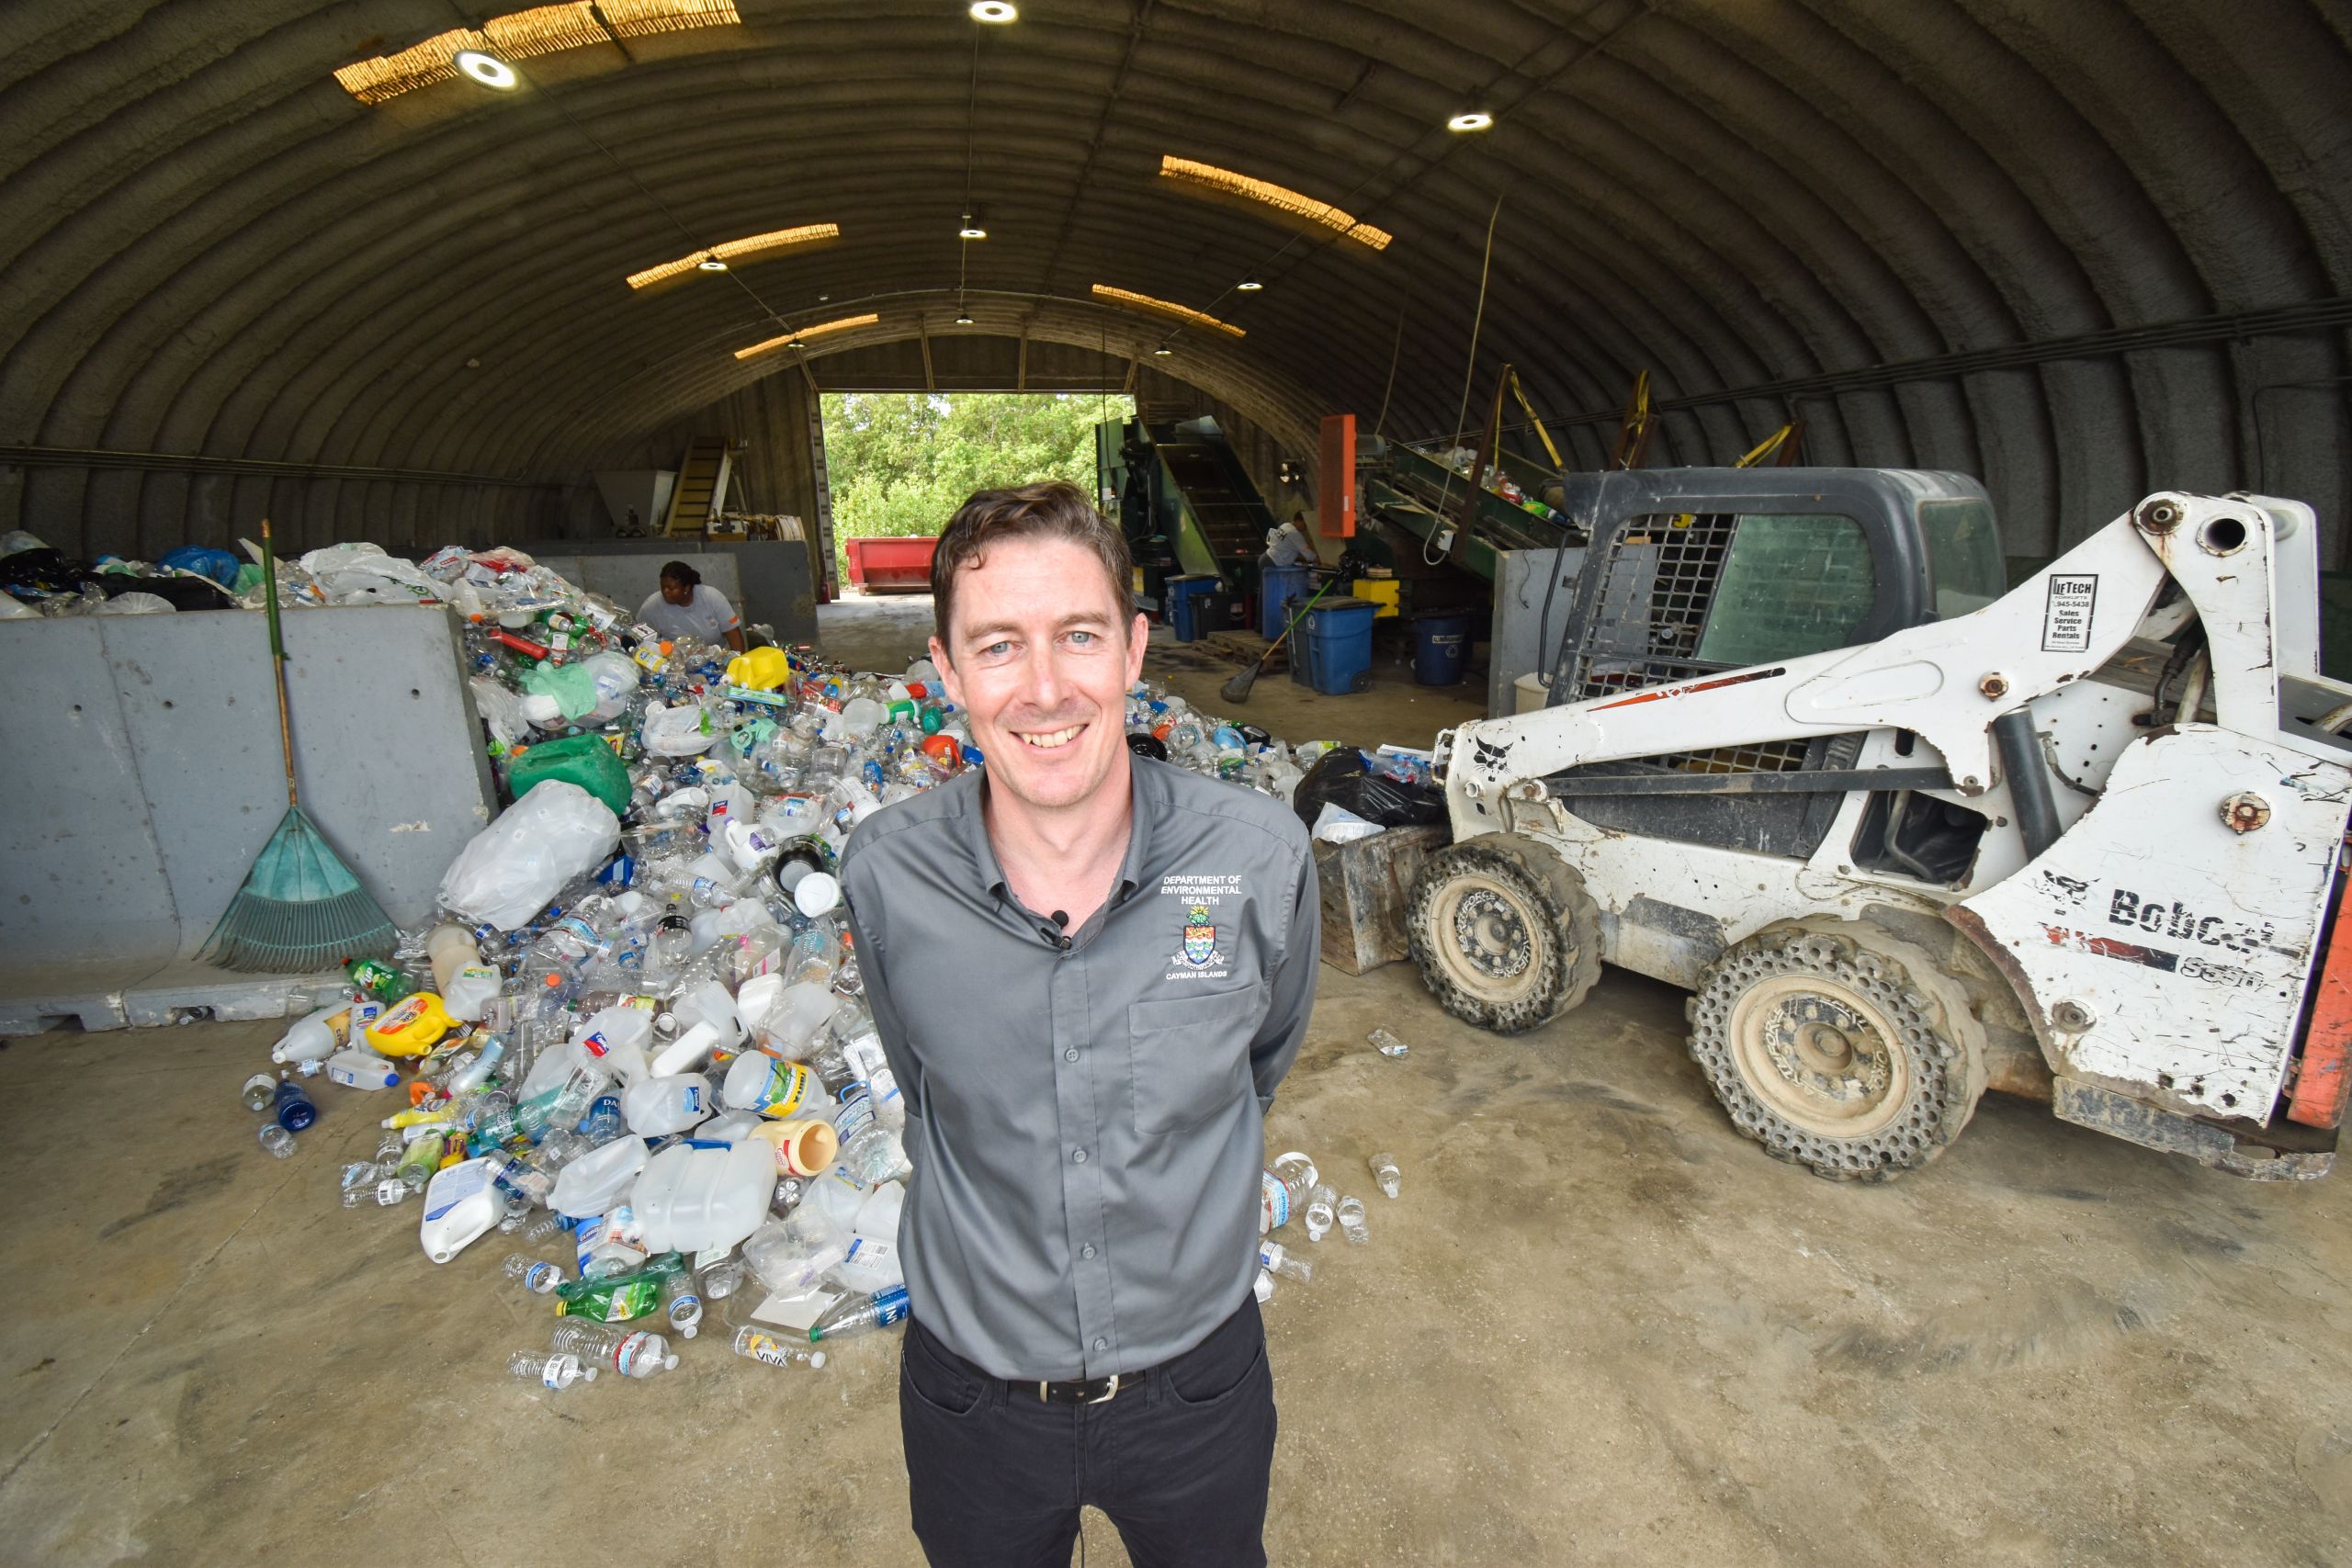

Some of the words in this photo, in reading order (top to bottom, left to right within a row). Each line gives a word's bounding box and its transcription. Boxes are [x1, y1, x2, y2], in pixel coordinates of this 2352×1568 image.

[1163, 875, 1224, 885] DEPARTMENT
[1227, 875, 1241, 885] OF
[1160, 886, 1241, 895] ENVIRONMENTAL
[1181, 896, 1219, 905] HEALTH
[1166, 970, 1197, 980] CAYMAN
[1198, 970, 1227, 978] ISLANDS
